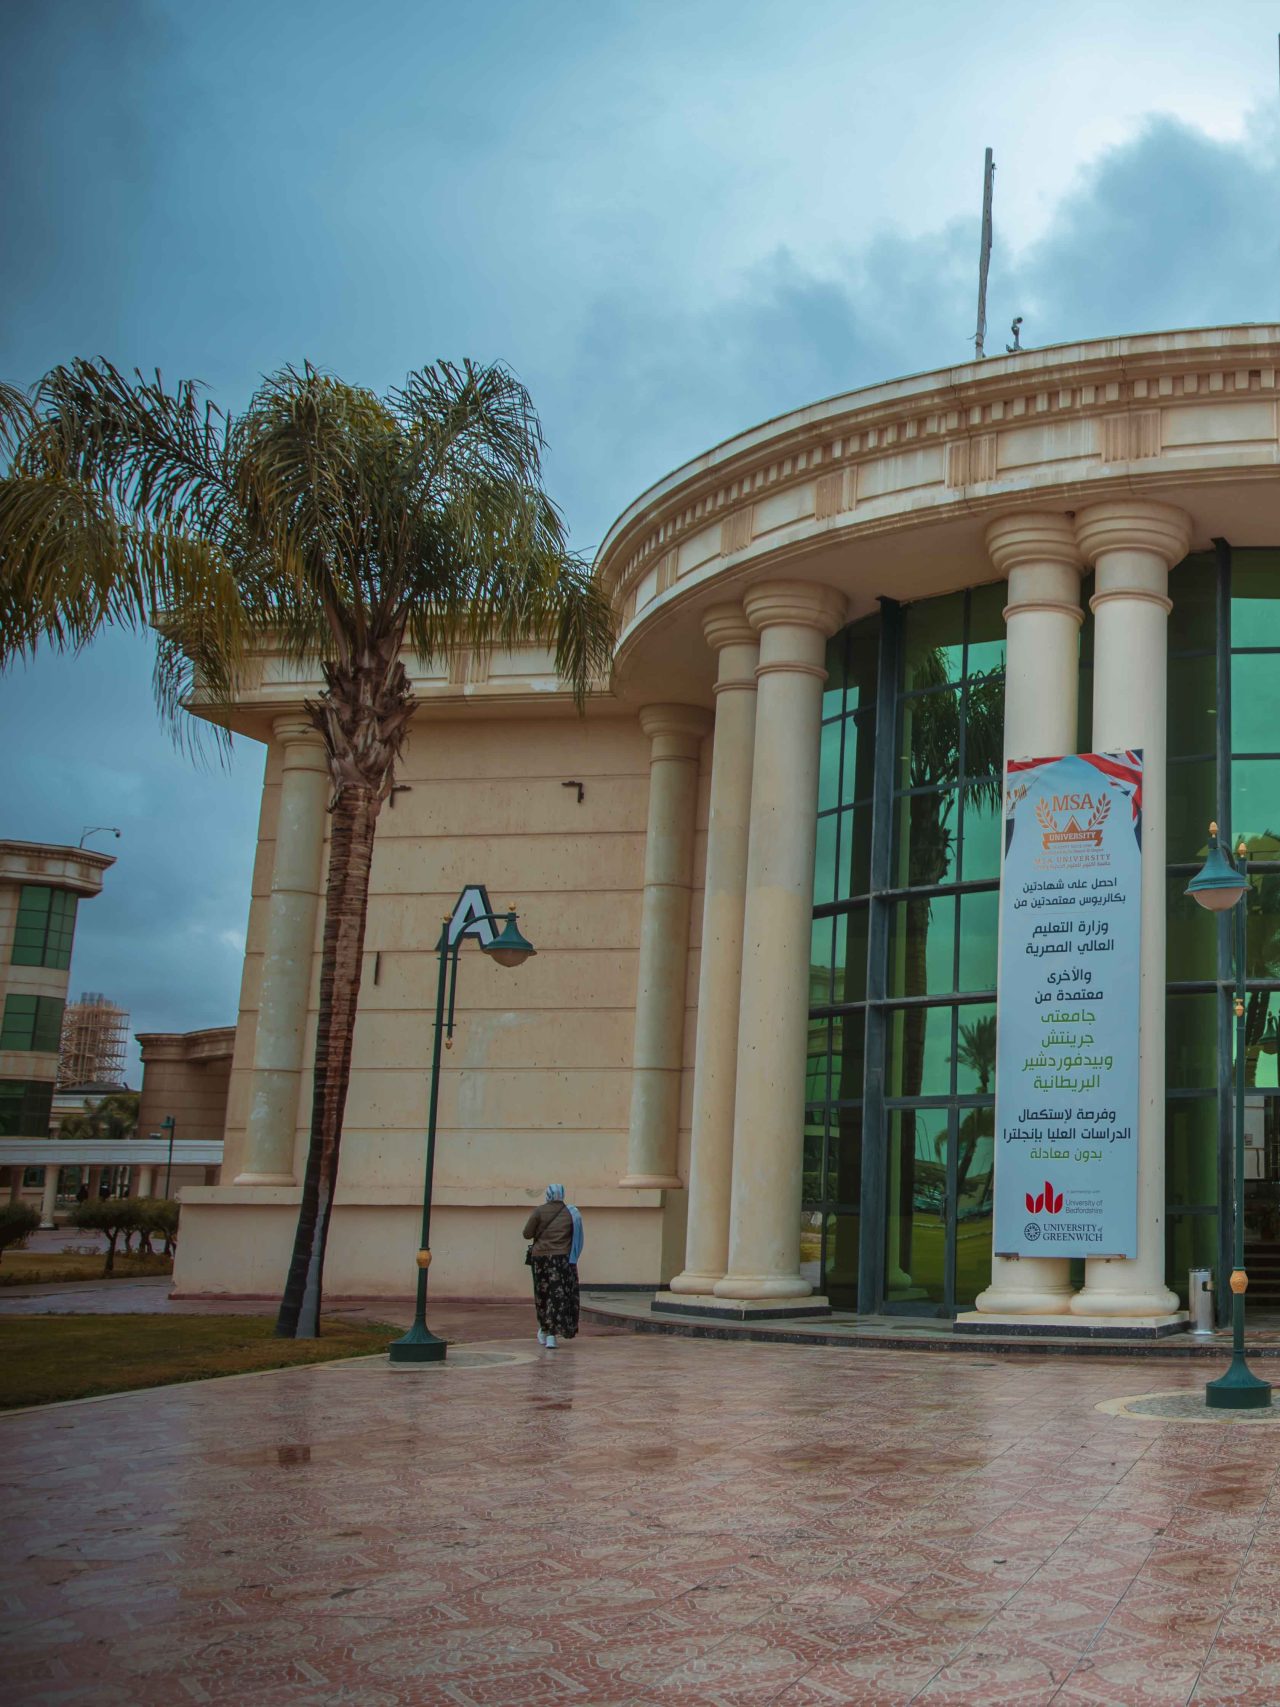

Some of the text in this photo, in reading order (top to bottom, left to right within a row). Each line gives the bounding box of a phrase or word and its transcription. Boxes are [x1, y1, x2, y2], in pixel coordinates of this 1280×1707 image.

[1052, 793, 1094, 812] MSA
[1050, 831, 1096, 841] UNIVERSITY
[1022, 877, 1117, 894] احصل على شهادتين
[1014, 892, 1126, 910] بكالريوس معتمدتين من
[435, 885, 500, 951] A
[1032, 920, 1109, 938] وزارة التعليم
[1026, 939, 1114, 958] العالي المصرية
[1047, 966, 1092, 985] والأخرى
[1034, 989, 1104, 1004] معتمدة من
[1042, 1029, 1094, 1048] جرينتش
[1022, 1051, 1113, 1072] وبيدفوردشير
[1034, 1074, 1100, 1092] البريطانية
[1018, 1108, 1116, 1124] وفرصة لإستكمال
[1004, 1128, 1131, 1144] الدراسات العليا بإنجلترا
[1030, 1147, 1103, 1162] بدون معادلة
[1042, 1232, 1103, 1242] GREENWICH
[1043, 1224, 1097, 1232] UNIVERSITY
